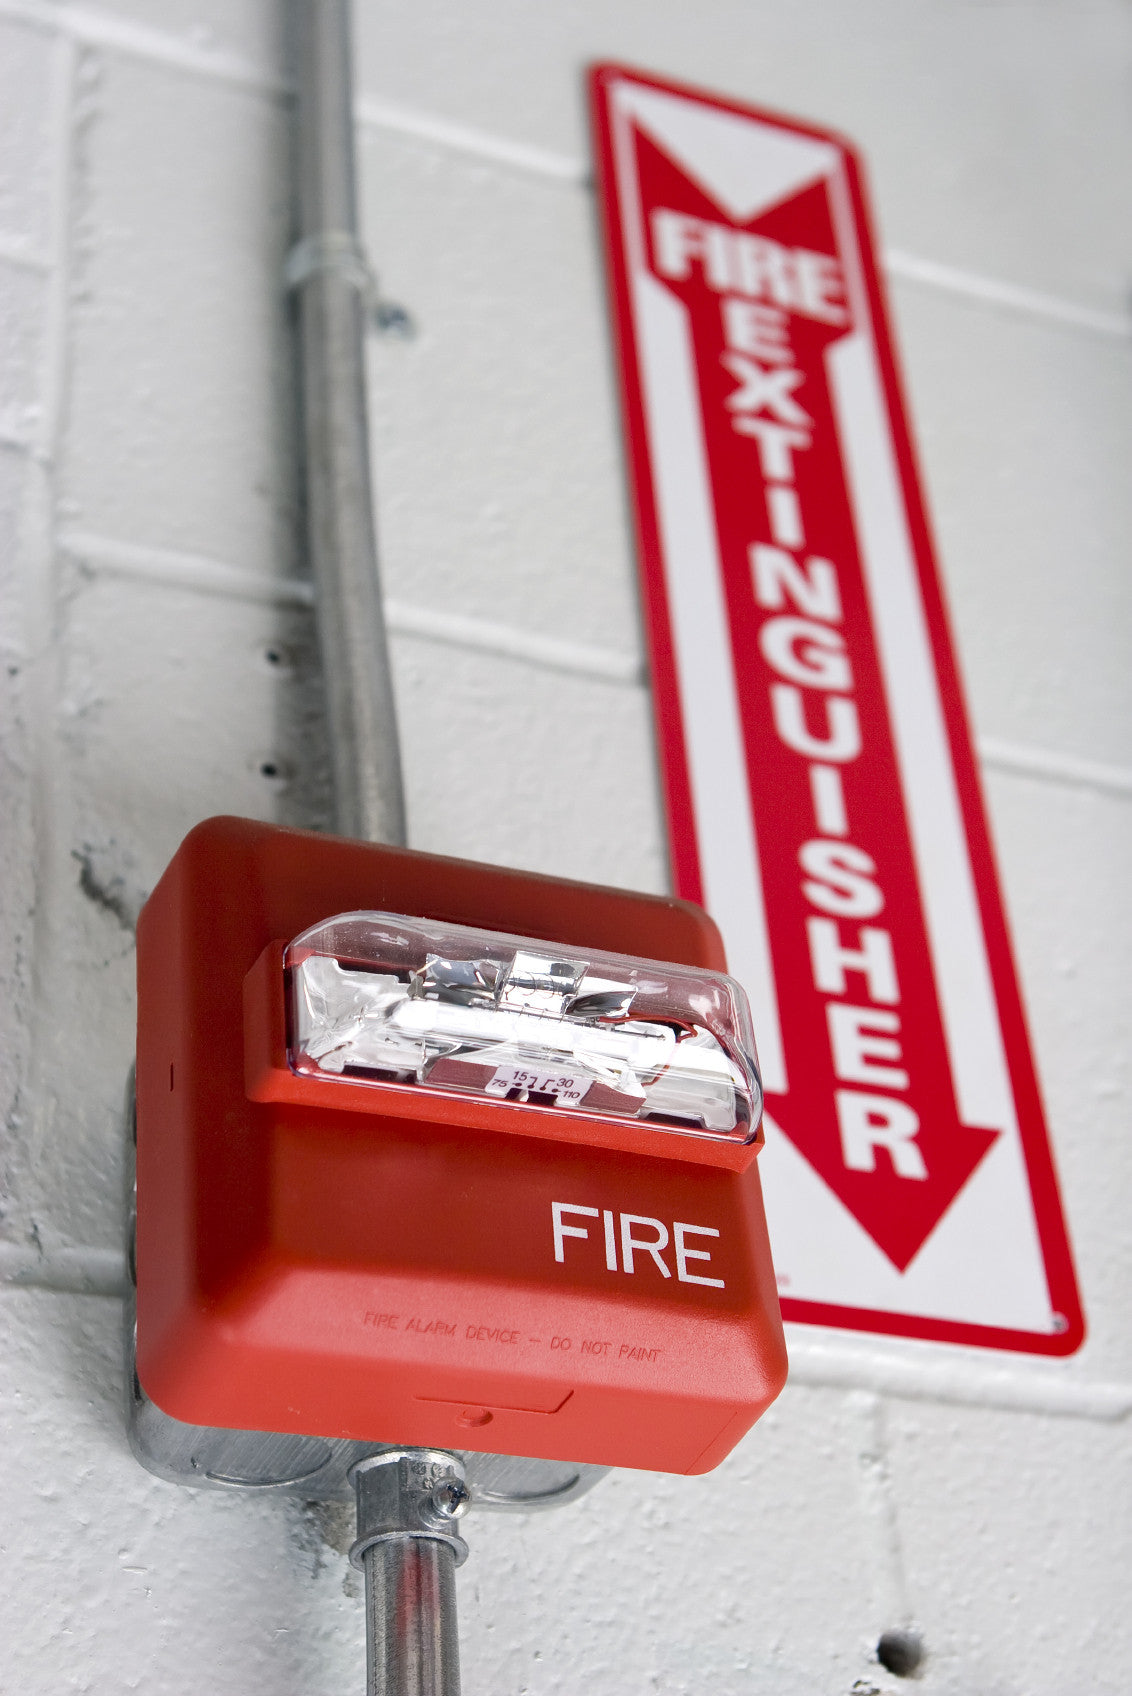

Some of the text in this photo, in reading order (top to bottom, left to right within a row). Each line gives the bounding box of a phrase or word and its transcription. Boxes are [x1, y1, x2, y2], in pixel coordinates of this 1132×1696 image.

[650, 206, 852, 328] FIRE
[720, 298, 929, 1182] EXTINGUISHER
[491, 1078, 508, 1088] 75
[512, 1070, 529, 1081] 15
[556, 1077, 574, 1088] 30
[563, 1090, 580, 1099] 110
[551, 1201, 725, 1289] FIRE
[363, 1310, 400, 1331] FIRE
[405, 1317, 457, 1338] ALARM
[465, 1325, 521, 1345] DEVICE
[550, 1336, 572, 1351] DO
[581, 1340, 612, 1357] NOT
[618, 1344, 662, 1363] PAINT
